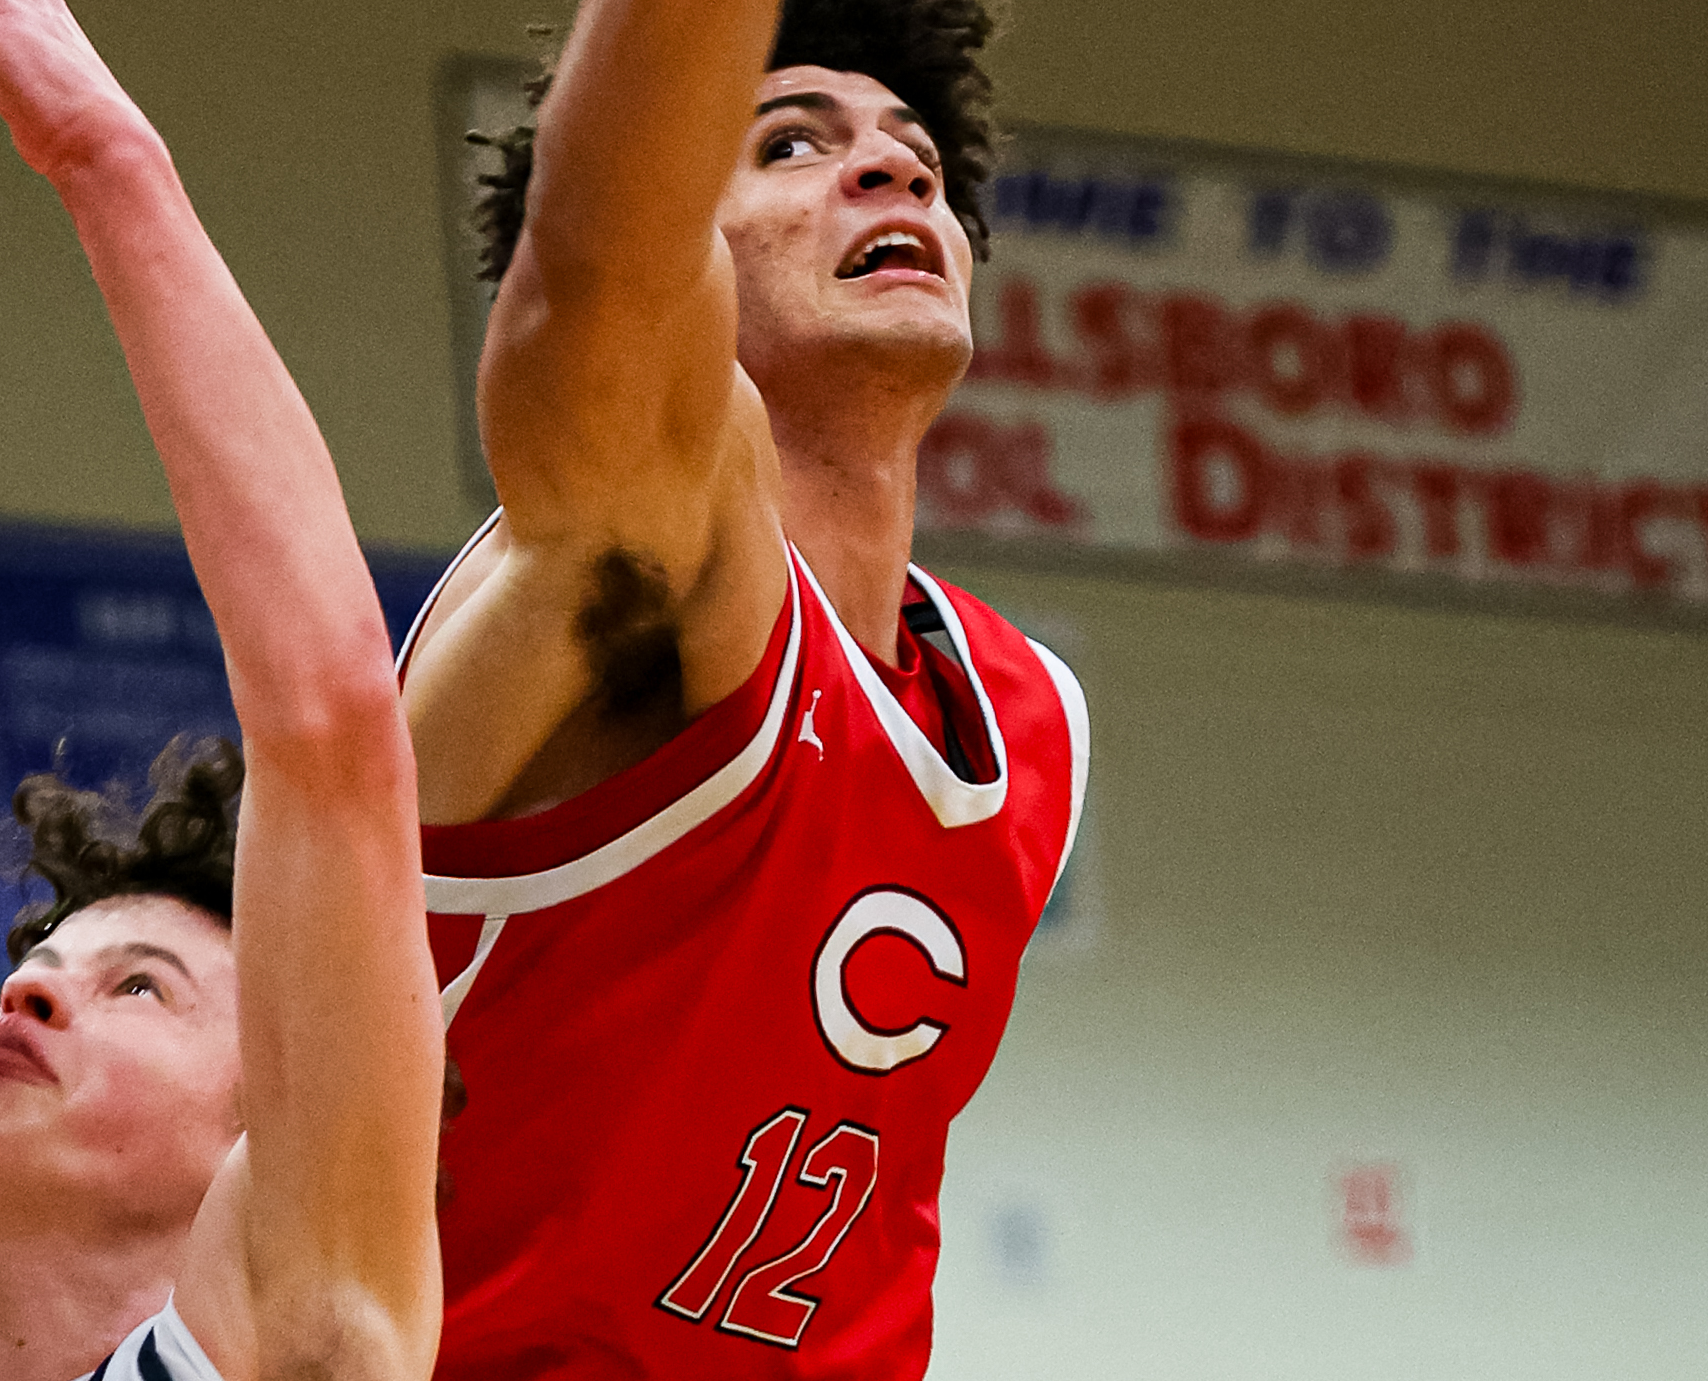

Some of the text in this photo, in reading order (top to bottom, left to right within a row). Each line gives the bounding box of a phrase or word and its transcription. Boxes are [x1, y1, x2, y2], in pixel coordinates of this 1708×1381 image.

[1248, 187, 1396, 275] TO
[1170, 420, 1708, 586] DISTRIC
[810, 883, 968, 1076] C
[654, 1104, 879, 1351] 12
